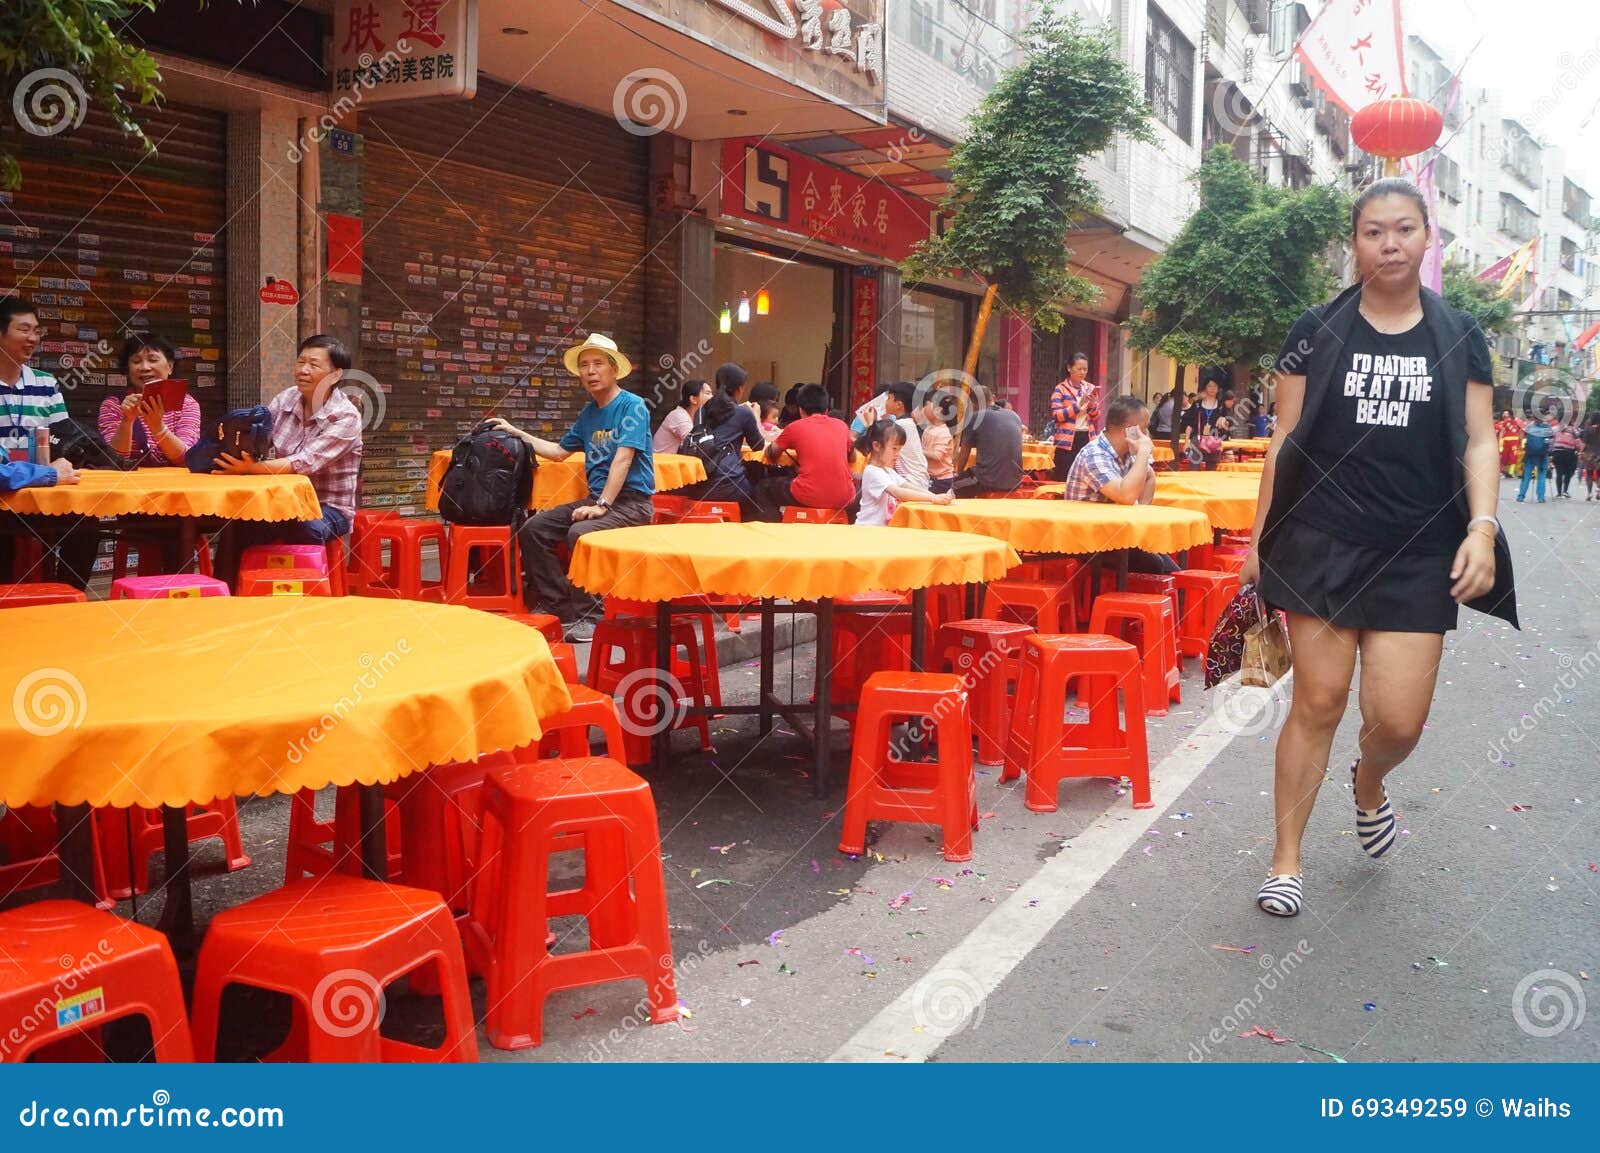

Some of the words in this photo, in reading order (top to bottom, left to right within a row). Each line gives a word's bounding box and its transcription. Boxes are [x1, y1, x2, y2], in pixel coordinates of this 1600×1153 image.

[1352, 353, 1372, 374] I'D
[1373, 355, 1428, 376] RATHER
[1343, 371, 1368, 397] BE
[1368, 374, 1395, 399] AT
[1398, 376, 1433, 402] THE
[1355, 398, 1411, 427] BEACH
